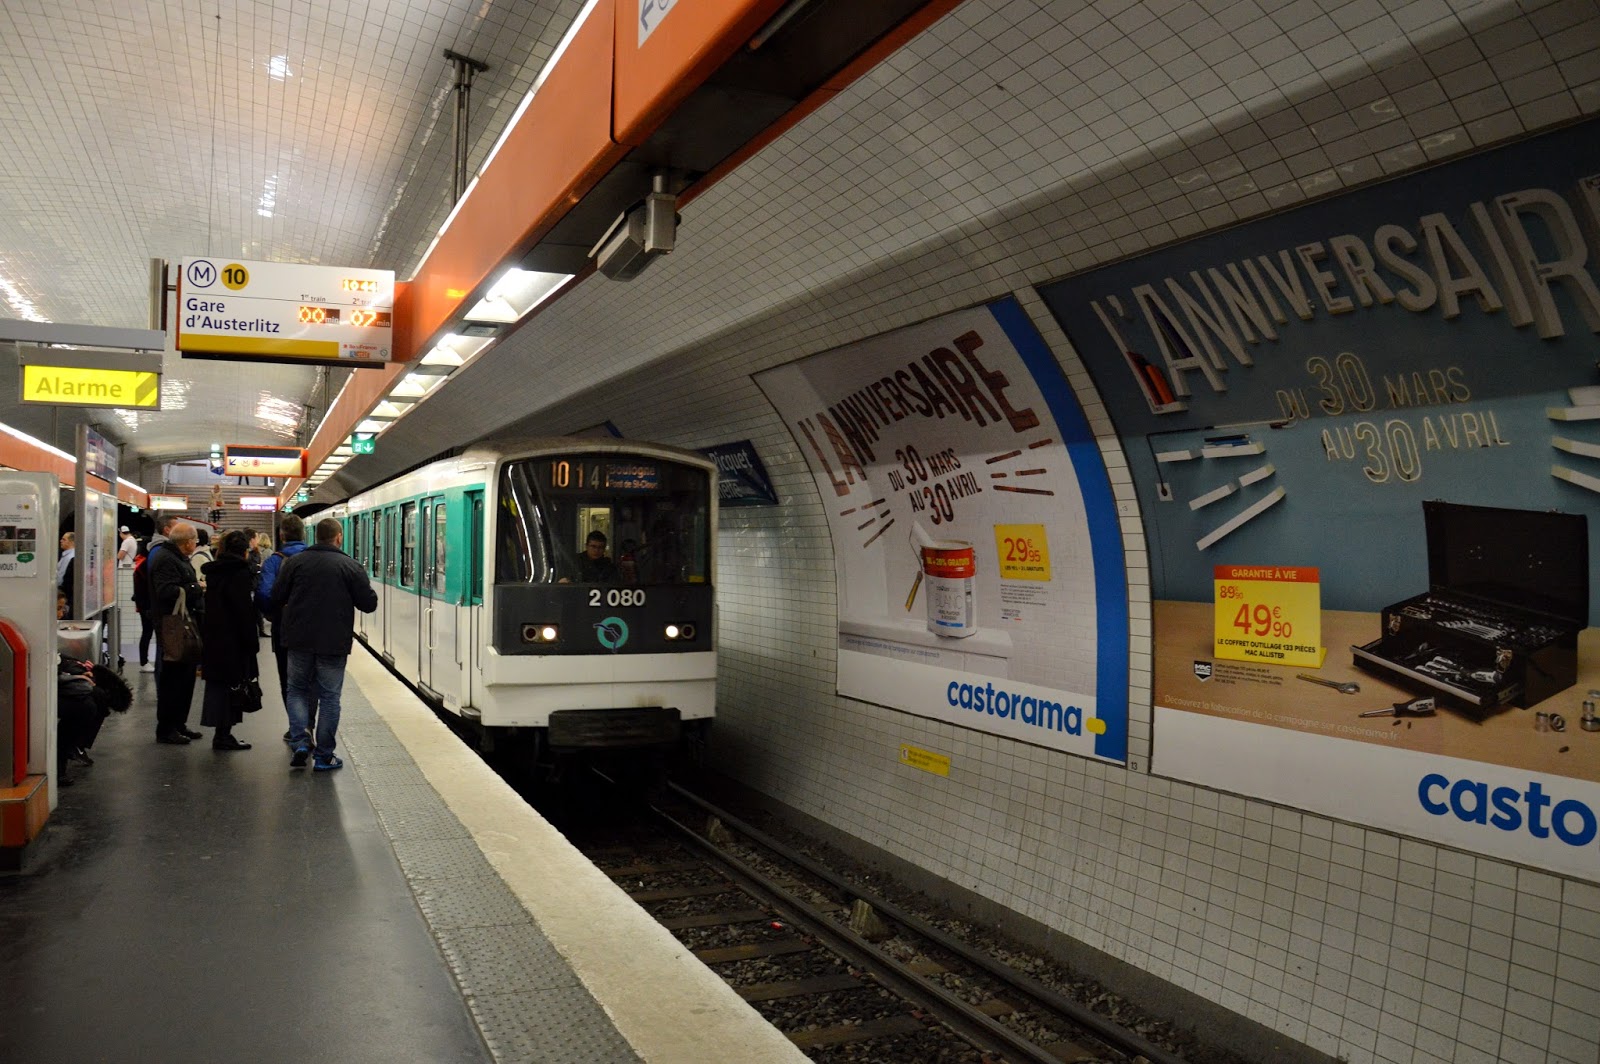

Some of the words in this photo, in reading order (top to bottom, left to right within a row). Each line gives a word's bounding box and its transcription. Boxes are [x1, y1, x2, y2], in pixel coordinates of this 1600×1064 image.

[224, 268, 246, 285] 10
[1090, 173, 1600, 414] L'ANNIVERSAIR
[186, 298, 225, 313] Gare
[300, 306, 325, 324] 00
[186, 315, 280, 333] d'Austerlitz
[326, 316, 340, 325] min
[350, 310, 376, 327] 07
[376, 319, 390, 327] min
[35, 376, 123, 398] Alarme
[1276, 388, 1310, 420] DU
[1307, 352, 1376, 415] 30
[1384, 367, 1471, 408] MARS
[798, 330, 1040, 497] L'ANNIVERSAIRE
[1321, 427, 1355, 461] AU
[1355, 419, 1422, 482] 30
[1423, 411, 1510, 450] AVRIL
[609, 465, 656, 478] Boulogne
[708, 448, 753, 475] Picquet
[895, 445, 928, 485] 30
[926, 448, 961, 477] MARS
[552, 460, 570, 488] 10
[888, 470, 905, 492] DU
[719, 481, 743, 499] nelle
[909, 490, 925, 512] AU
[923, 483, 954, 525] 30
[946, 471, 982, 500] AVRIL
[1232, 569, 1273, 578] GARANTIE
[1274, 567, 1281, 579] À
[1283, 570, 1297, 579] VIE
[589, 589, 601, 606] 2
[606, 589, 646, 606] 080
[1225, 639, 1249, 647] COFFRET
[1250, 641, 1281, 650] OUTILLAGE
[1259, 650, 1285, 659] ALLISTER
[947, 681, 1082, 736] castorama
[1164, 694, 1202, 708] Découvrez
[1210, 702, 1251, 717] fabrication
[1252, 708, 1263, 718] de
[1274, 713, 1319, 729] campagne
[1337, 723, 1399, 740] castorama.fr
[1418, 773, 1597, 846] casto
